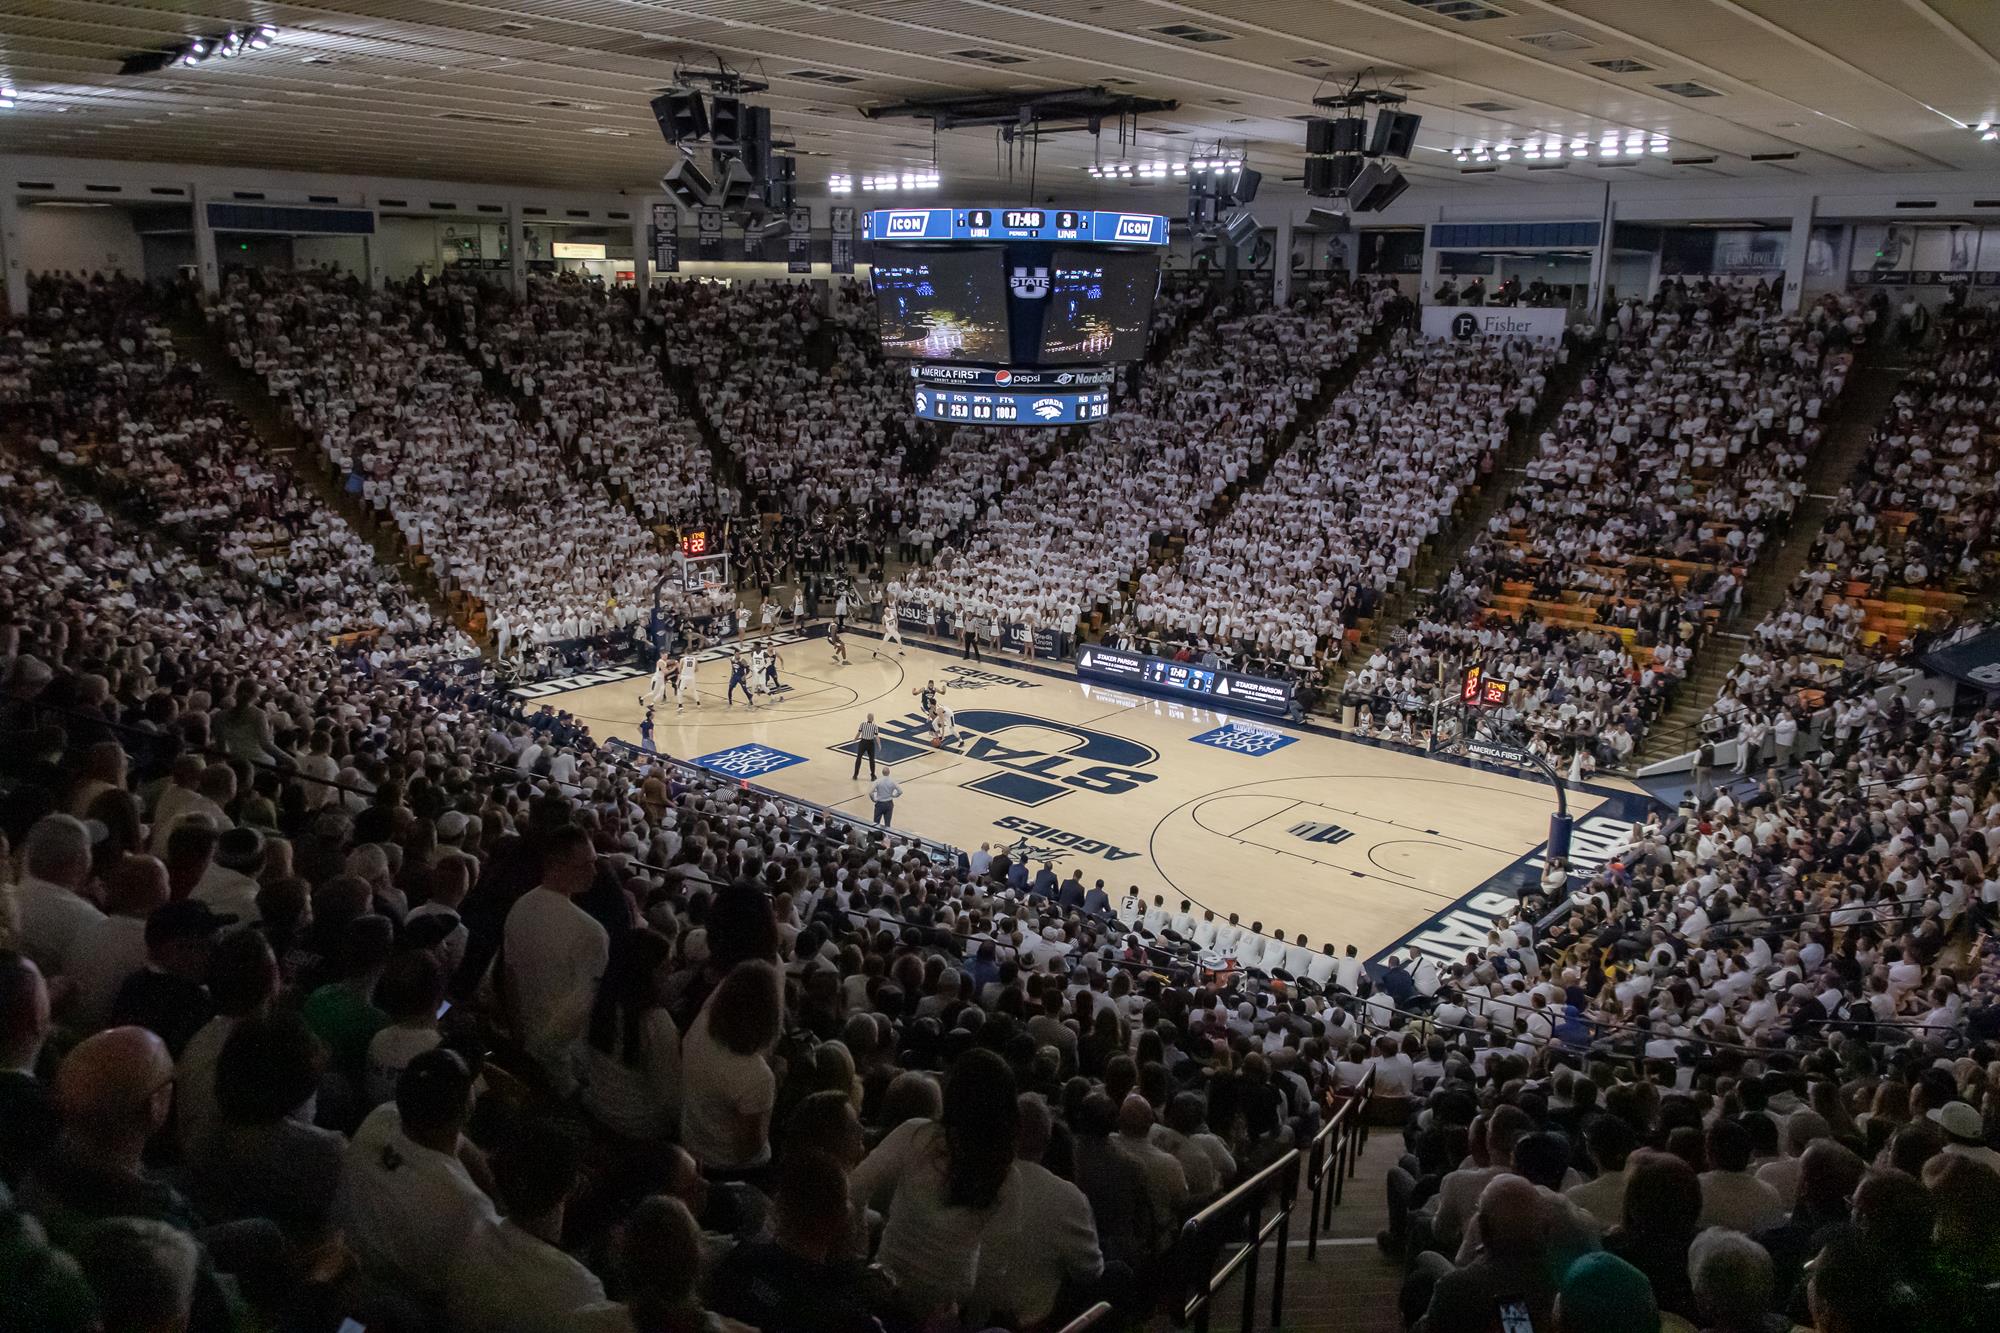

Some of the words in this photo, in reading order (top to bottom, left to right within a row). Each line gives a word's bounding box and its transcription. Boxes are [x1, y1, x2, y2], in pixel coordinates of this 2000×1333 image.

[893, 218, 921, 230] ICON
[975, 212, 984, 226] 4
[1007, 212, 1040, 227] 17:48
[1063, 213, 1072, 227] 3
[1057, 230, 1077, 239] UNR
[1123, 222, 1148, 234] ICON
[1010, 277, 1050, 288] STATE
[1459, 318, 1473, 336] F
[1484, 316, 1533, 333] Fisher
[921, 367, 952, 379] AMERICA
[953, 370, 980, 380] FIRST
[1013, 374, 1041, 383] pepsi
[938, 403, 944, 415] 4
[951, 404, 968, 417] 25.0
[1032, 398, 1064, 410] NEVADA
[973, 406, 991, 418] 0.0
[996, 406, 1017, 419] 100.0
[1079, 405, 1086, 418] 4
[691, 539, 704, 552] 22
[1097, 653, 1118, 663] STAKER
[1118, 657, 1139, 667] PARSON
[509, 665, 649, 697] UTAH
[941, 665, 1042, 689] AGGIES
[1154, 671, 1160, 682] 4
[1192, 680, 1200, 689] 3
[1235, 680, 1259, 692] STAKER
[1258, 685, 1283, 696] PARSON
[1465, 678, 1478, 697] 22
[1488, 689, 1502, 701] 22
[878, 712, 1159, 795] STATE
[1468, 744, 1501, 757] AMERICA
[1501, 751, 1523, 761] FIRST
[992, 815, 1143, 861] AGGIES
[1126, 900, 1134, 909] 2
